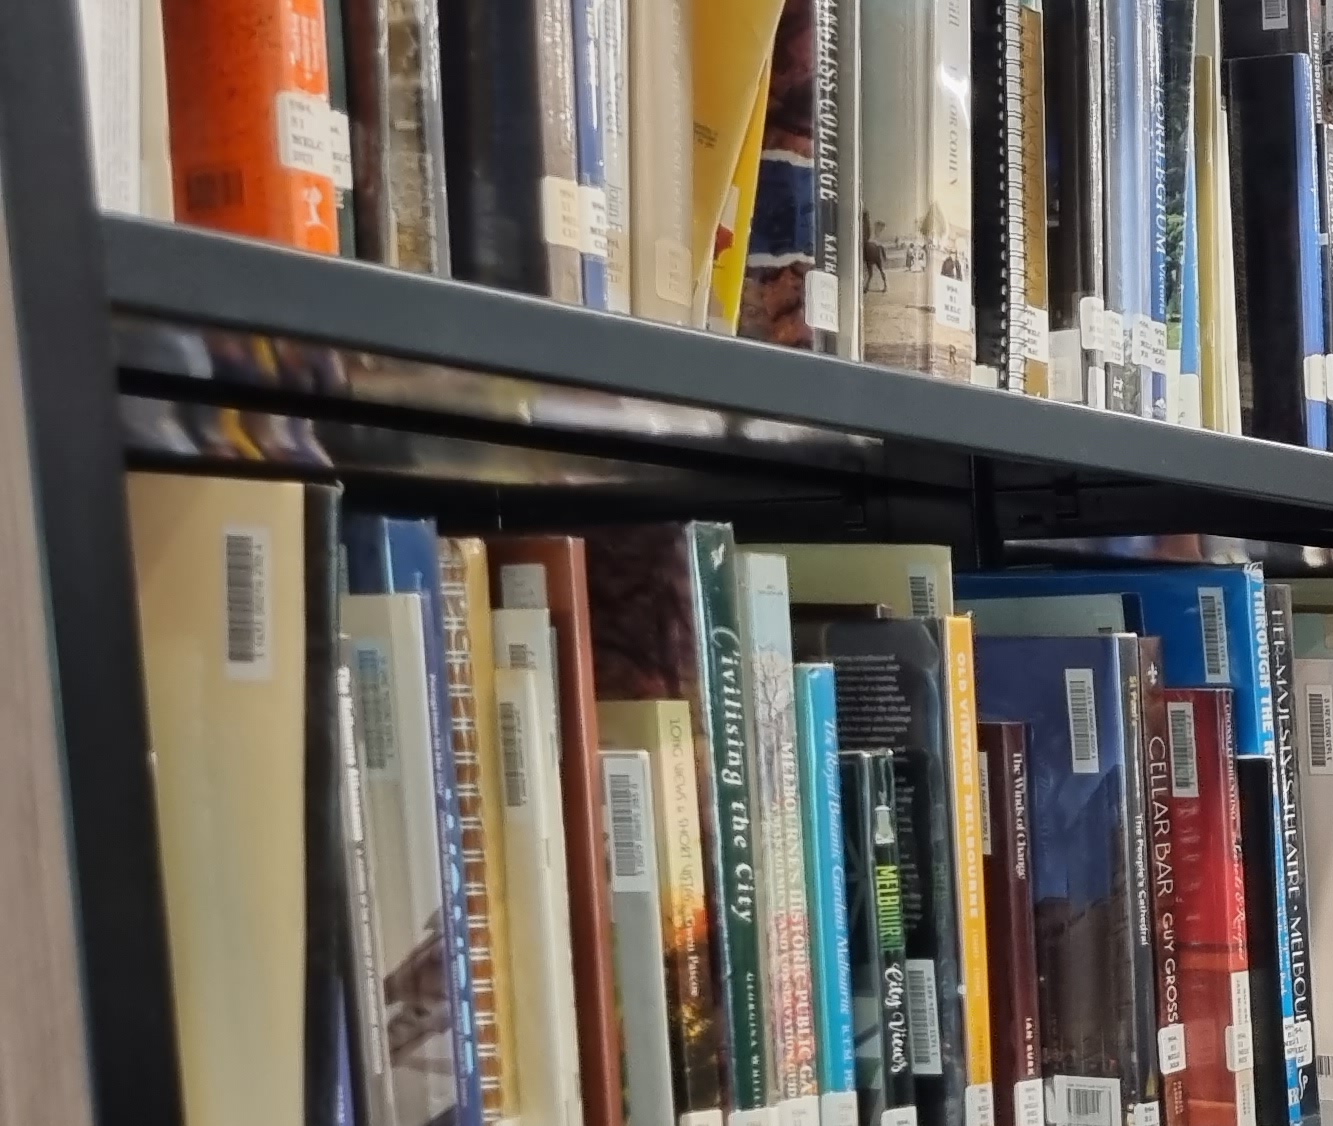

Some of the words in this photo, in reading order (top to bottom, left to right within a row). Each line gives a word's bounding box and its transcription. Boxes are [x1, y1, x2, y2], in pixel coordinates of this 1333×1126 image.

[1312, 53, 1321, 91] HIDDEN
[819, 98, 839, 203] COLLEGE
[823, 233, 838, 274] KATH
[1156, 262, 1167, 316] Victoria
[1252, 589, 1271, 689] THROUGH
[956, 652, 968, 692] OLD
[709, 626, 746, 787] Civilising
[1261, 694, 1274, 734] THE
[959, 699, 973, 785] VINTAGE
[1012, 752, 1023, 775] The
[823, 750, 841, 796] Royal
[1014, 778, 1025, 817] Winds
[1147, 736, 1171, 838] CELLAR
[678, 818, 691, 860] SHORT
[730, 801, 751, 848] the
[827, 801, 843, 860] Botanic
[1016, 818, 1026, 831] of
[1134, 813, 1144, 835] The
[963, 786, 979, 919] MELBOURNE
[1014, 834, 1027, 880] Change
[1135, 838, 1147, 888] People's
[1154, 842, 1173, 898] BAR
[733, 863, 756, 923] City
[831, 865, 848, 932] Gardens
[874, 864, 904, 954] MELBOURNE
[1137, 890, 1149, 946] Cathedral
[789, 890, 809, 986] HISTORIC
[1161, 911, 1175, 952] GUY
[836, 935, 851, 1015] Melbourne
[884, 962, 907, 1009] City
[1164, 958, 1179, 1025] GROSS
[778, 916, 790, 950] AND
[787, 1064, 798, 1096] GUID
[795, 989, 813, 1061] PUBLIC
[1025, 1017, 1033, 1040] IAN
[887, 1012, 909, 1074] Views
